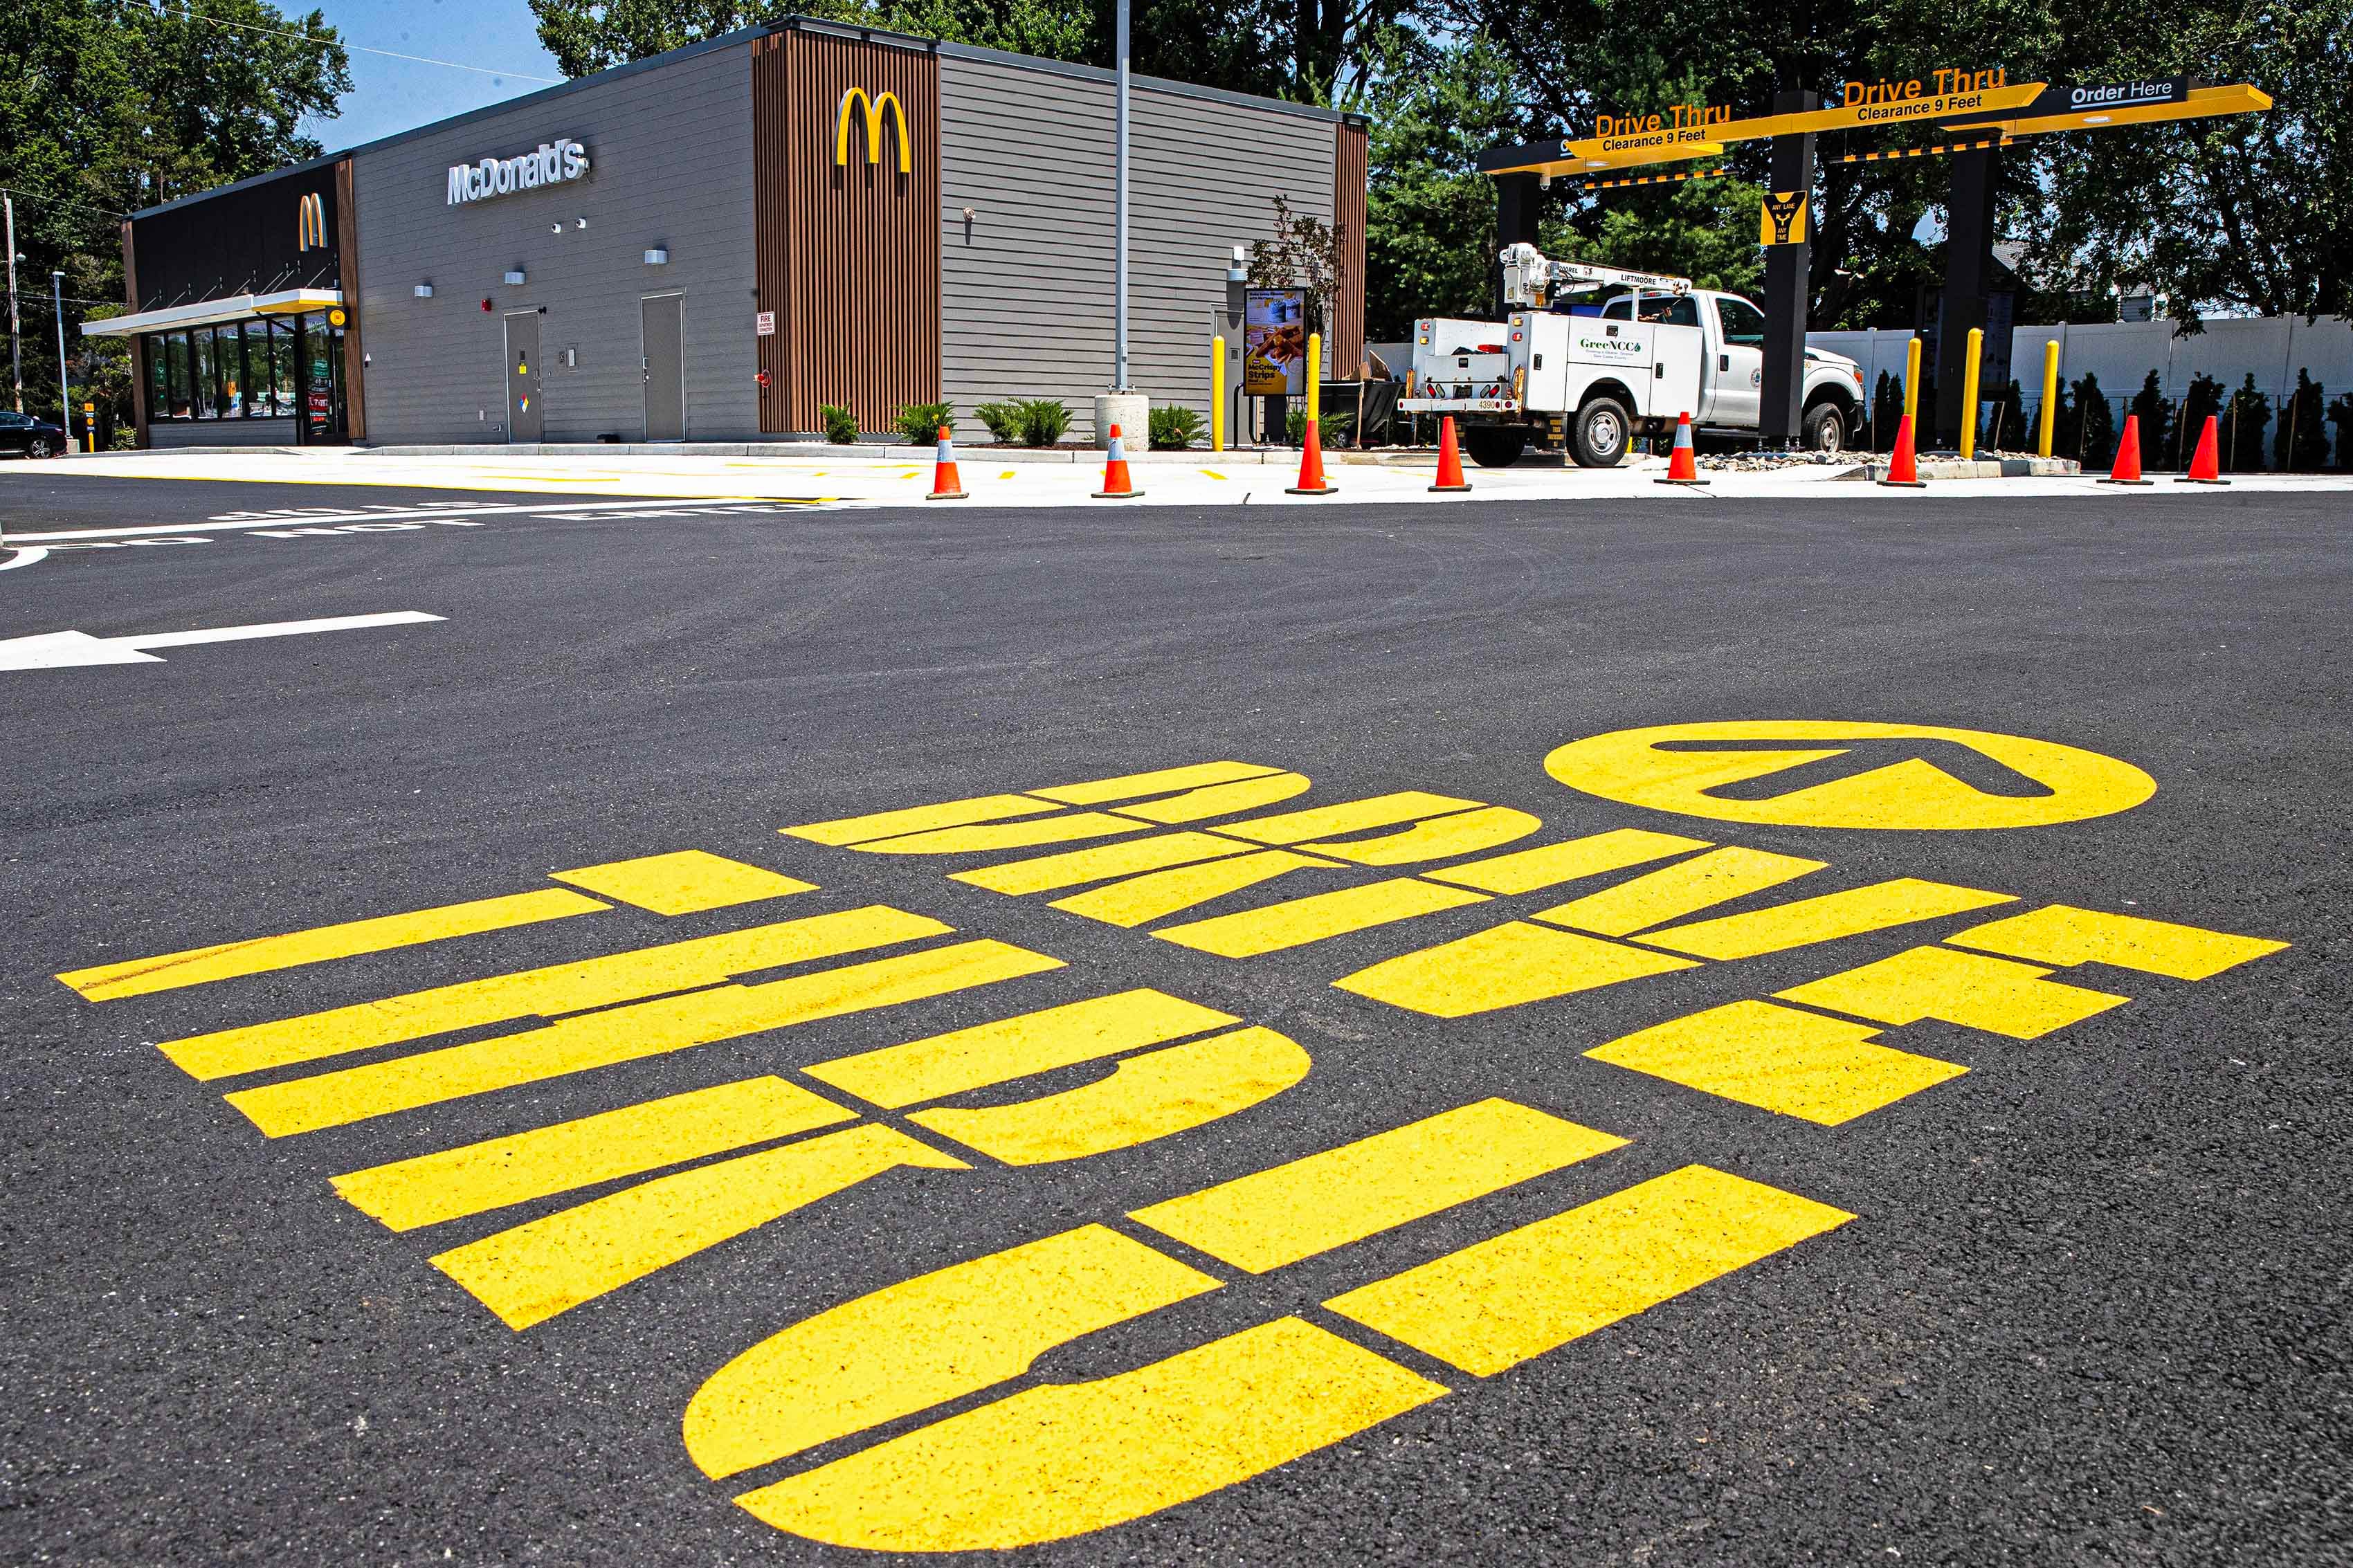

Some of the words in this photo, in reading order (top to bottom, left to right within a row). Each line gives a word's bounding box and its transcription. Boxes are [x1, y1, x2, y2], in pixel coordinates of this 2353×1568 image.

[1844, 78, 1921, 107] Drive
[1932, 68, 2005, 95] Thru
[2071, 86, 2125, 104] Order
[2130, 81, 2172, 98] Here
[1857, 102, 1929, 120] Clearance
[1934, 99, 1943, 111] 9
[1948, 94, 1981, 109] Feet
[1596, 112, 1661, 138] Drive
[1669, 104, 1730, 128] Thru
[1603, 134, 1663, 152] Clearance
[1666, 131, 1674, 143] 9
[1678, 129, 1706, 143] Feet
[447, 138, 585, 206] McDonald's
[1621, 273, 1656, 285] LIFTMOORE
[1580, 338, 1634, 352] GreeNCC
[1248, 364, 1282, 372] McCrispy
[1248, 370, 1275, 380] Strips
[1478, 400, 1495, 410] 4390
[208, 502, 517, 521] STOP
[244, 519, 486, 538] NOT
[529, 503, 880, 521] ENTER
[779, 760, 2289, 1126] DRIVE
[55, 849, 1858, 1552] THRU
